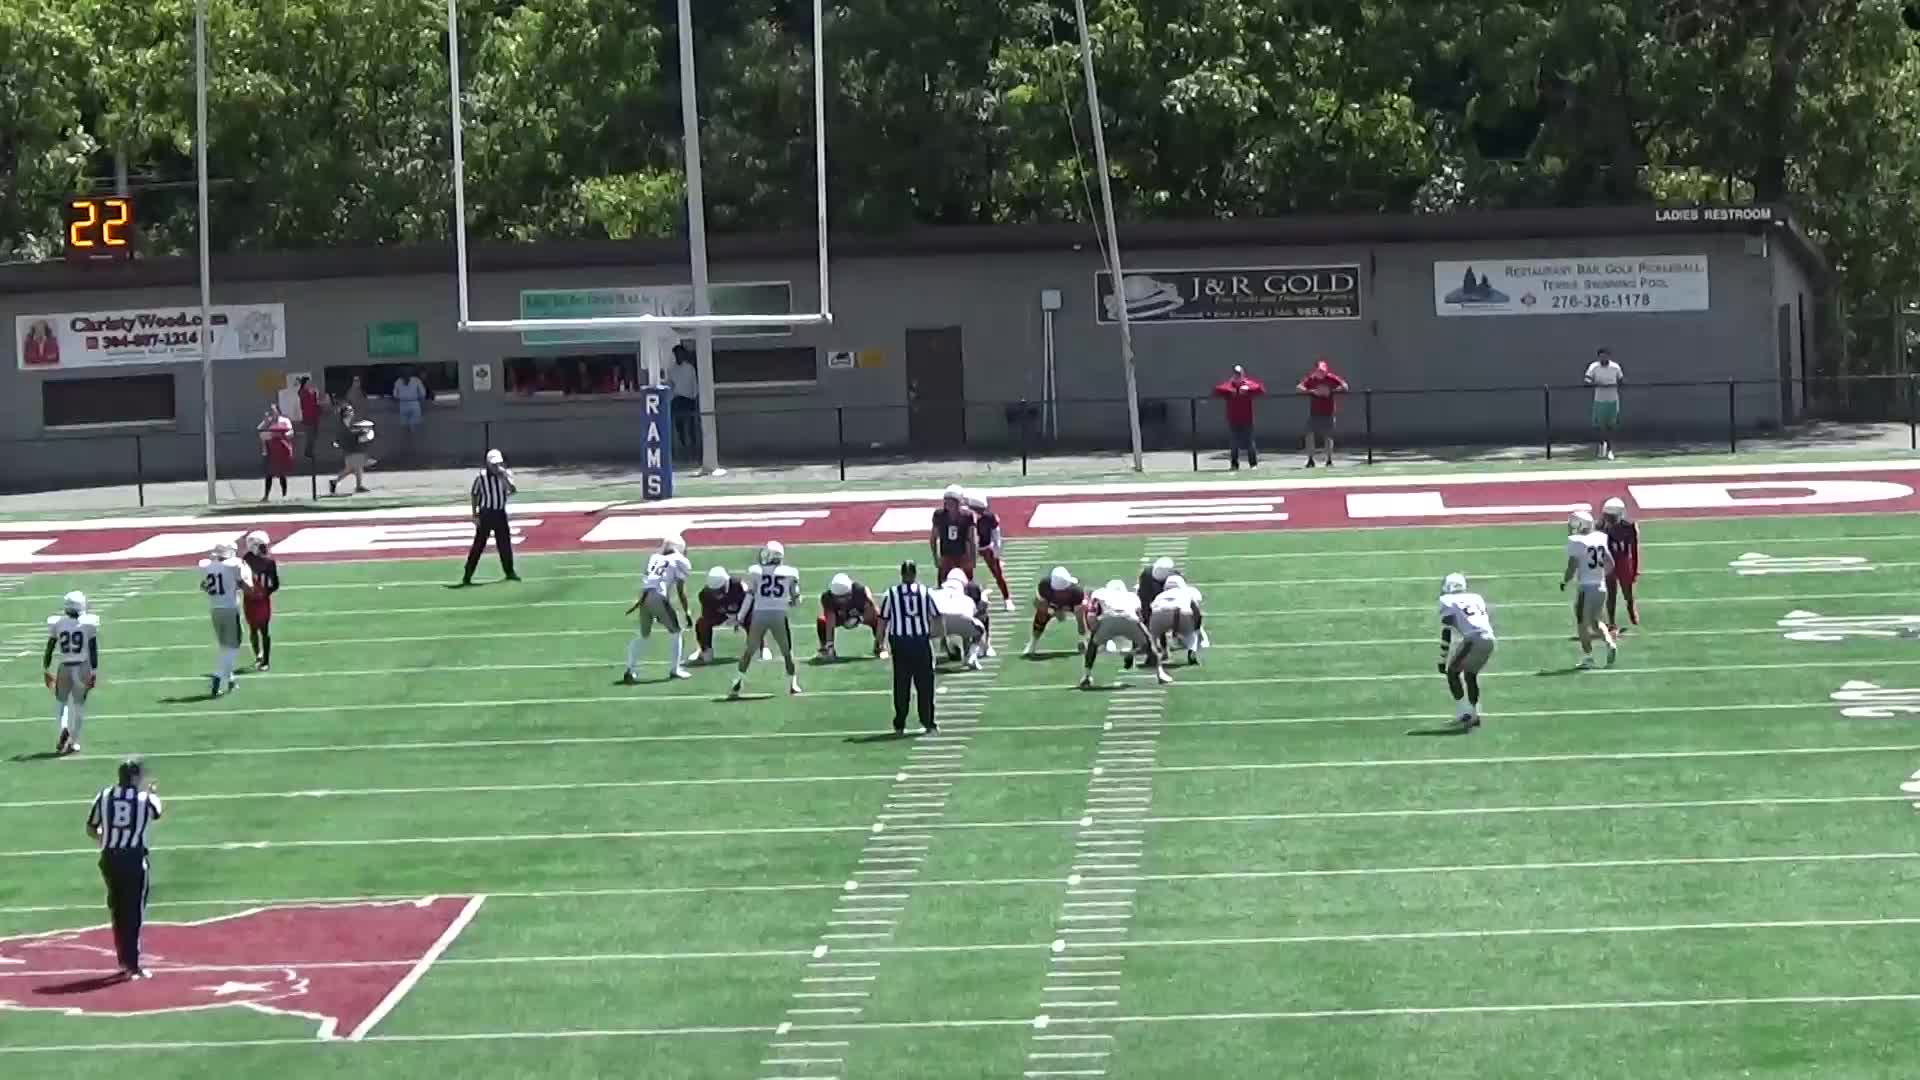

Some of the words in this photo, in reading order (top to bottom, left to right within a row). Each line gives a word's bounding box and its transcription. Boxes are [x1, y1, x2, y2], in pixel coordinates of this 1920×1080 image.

[71, 200, 127, 246] 22
[1655, 208, 1698, 221] LADIES
[1703, 207, 1771, 220] RESTROOM
[1263, 273, 1354, 295] GOLD
[1551, 294, 1650, 308] 276-326-1178
[70, 311, 228, 334] ChristyWood.cm
[644, 392, 662, 496] RAMS
[206, 572, 226, 596] 21
[760, 574, 786, 598] 25
[904, 595, 918, 616] U
[58, 630, 84, 654] 29
[113, 800, 132, 827] B
